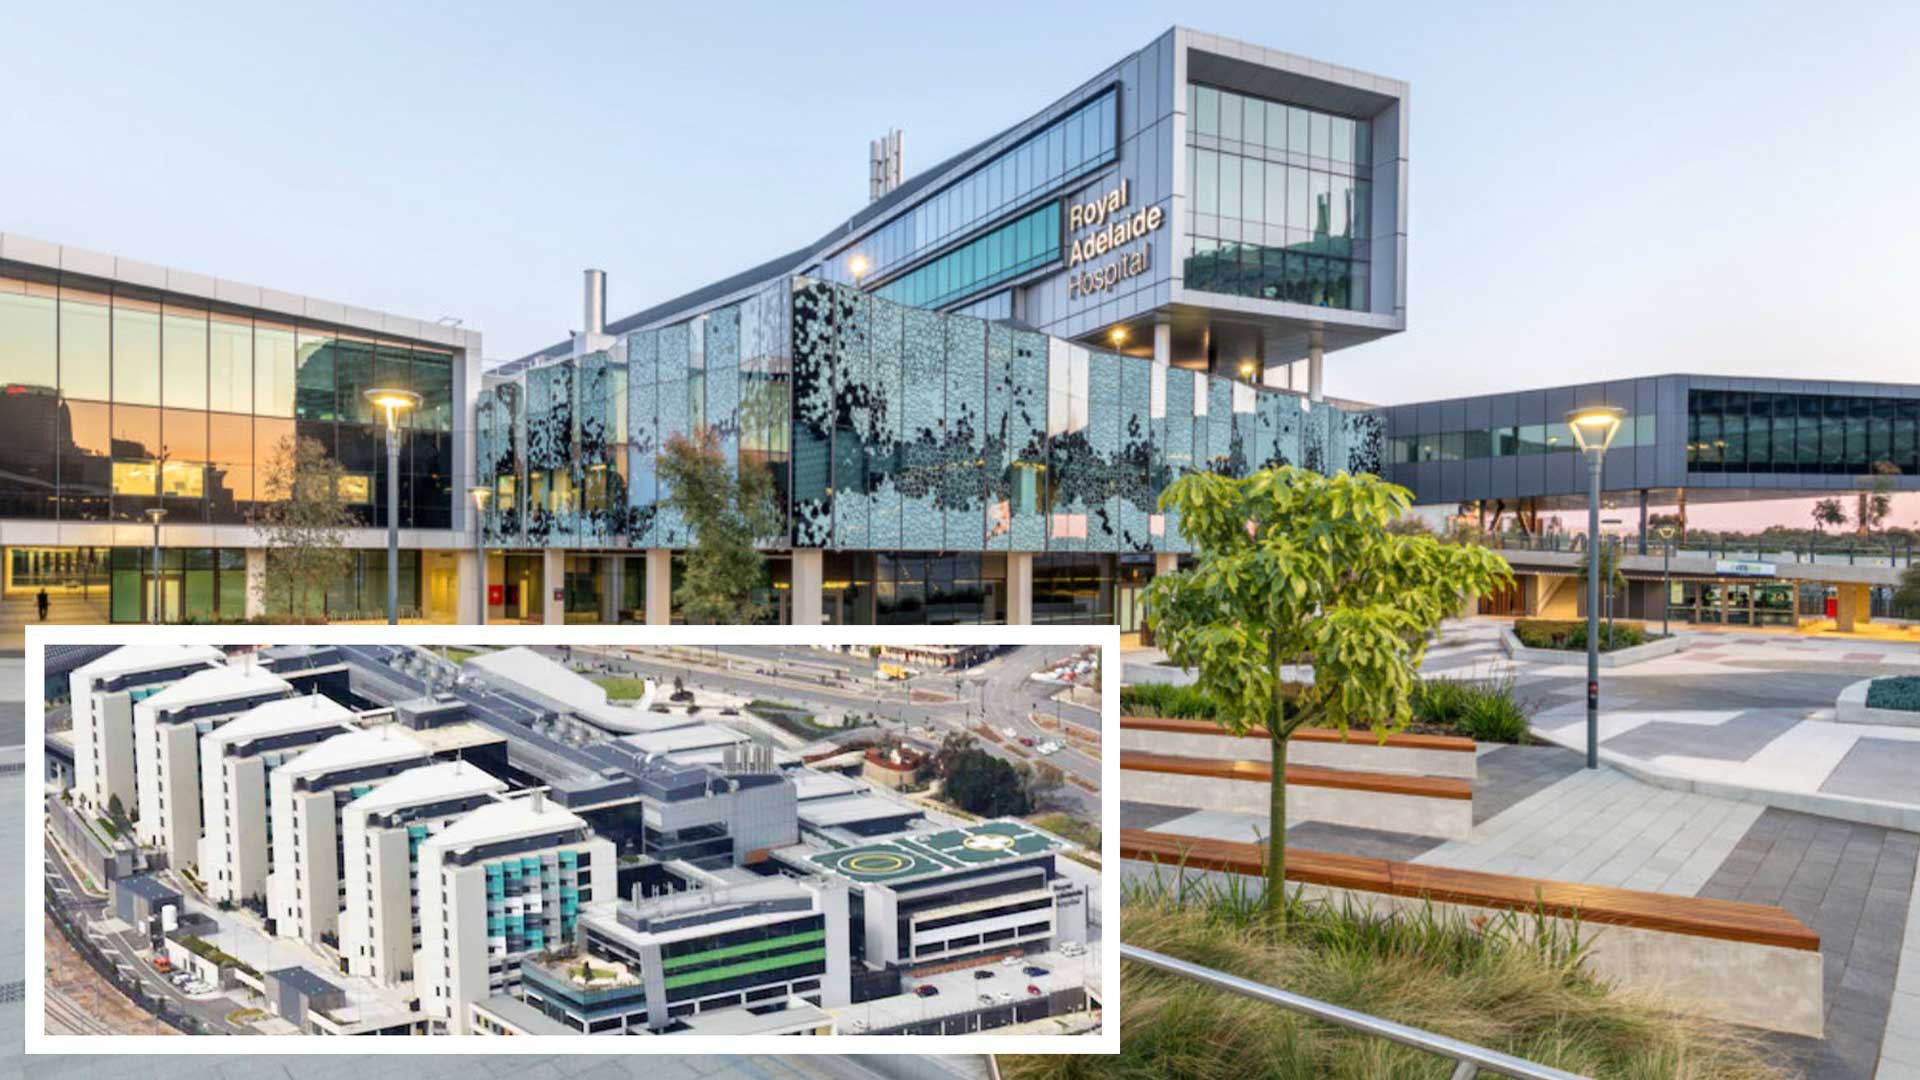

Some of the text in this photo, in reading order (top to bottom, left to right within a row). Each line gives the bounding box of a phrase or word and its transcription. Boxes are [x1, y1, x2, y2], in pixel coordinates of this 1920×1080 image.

[1069, 177, 1129, 231] Royal
[1069, 205, 1165, 267] Adelaide
[1068, 241, 1151, 299] Hospital
